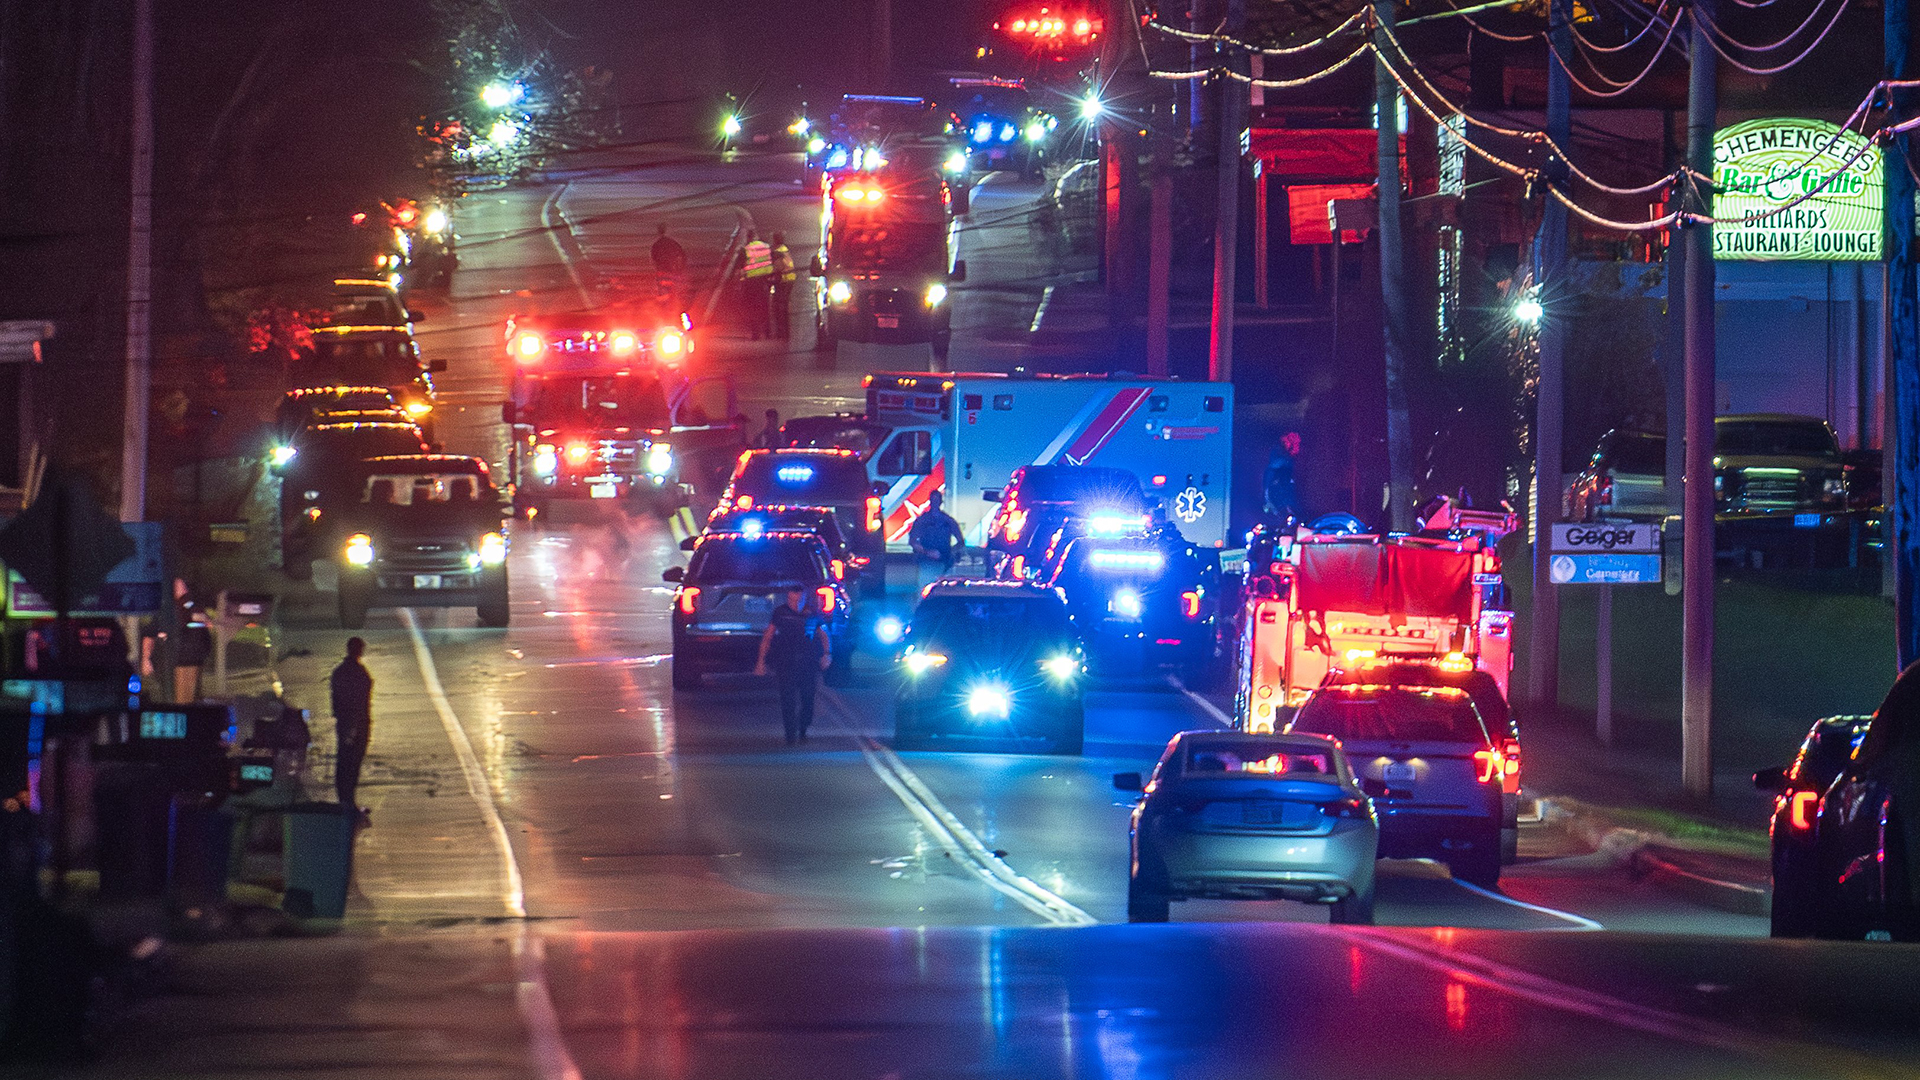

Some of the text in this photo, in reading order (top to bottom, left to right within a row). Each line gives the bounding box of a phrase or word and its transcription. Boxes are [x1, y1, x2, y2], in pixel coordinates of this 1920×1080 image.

[1722, 168, 1763, 194] Bar
[1765, 161, 1801, 200] &
[1744, 208, 1827, 229] BILLIARDS
[1715, 232, 1876, 252] STAURANT LOUNGE
[1566, 528, 1636, 549] Geiger
